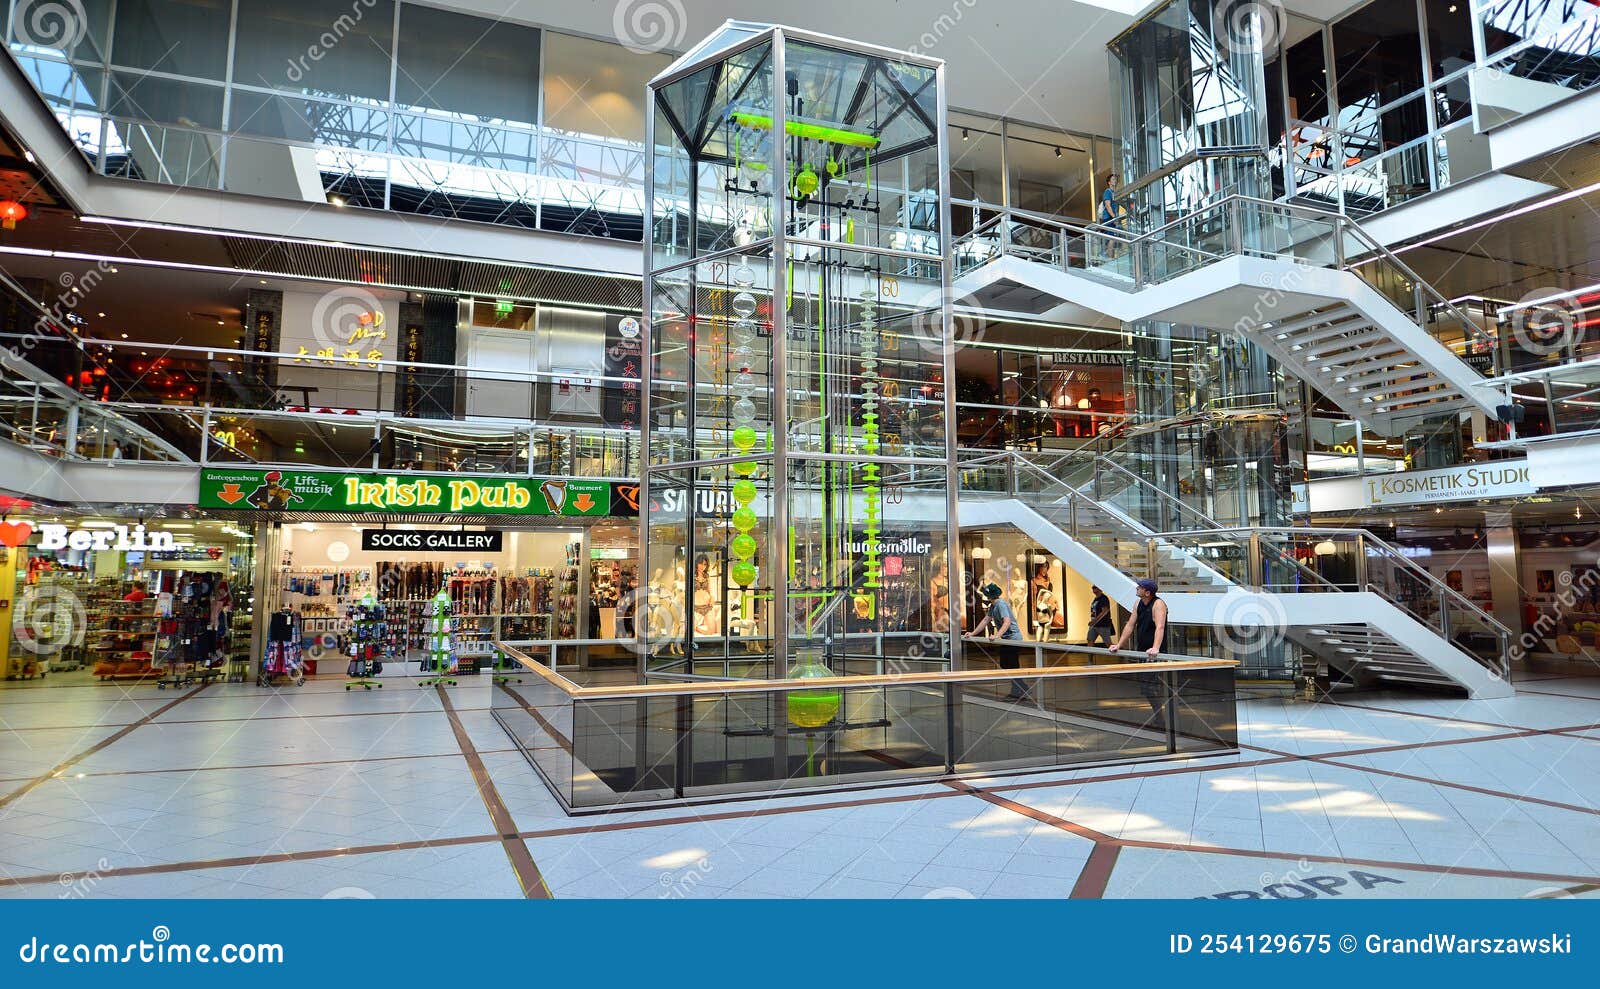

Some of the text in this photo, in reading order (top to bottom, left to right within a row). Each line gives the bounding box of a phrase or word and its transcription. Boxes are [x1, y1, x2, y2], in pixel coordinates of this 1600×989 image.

[882, 277, 898, 297] 60
[448, 480, 531, 511] Pub
[371, 534, 494, 548] SOCKS GALLERY
